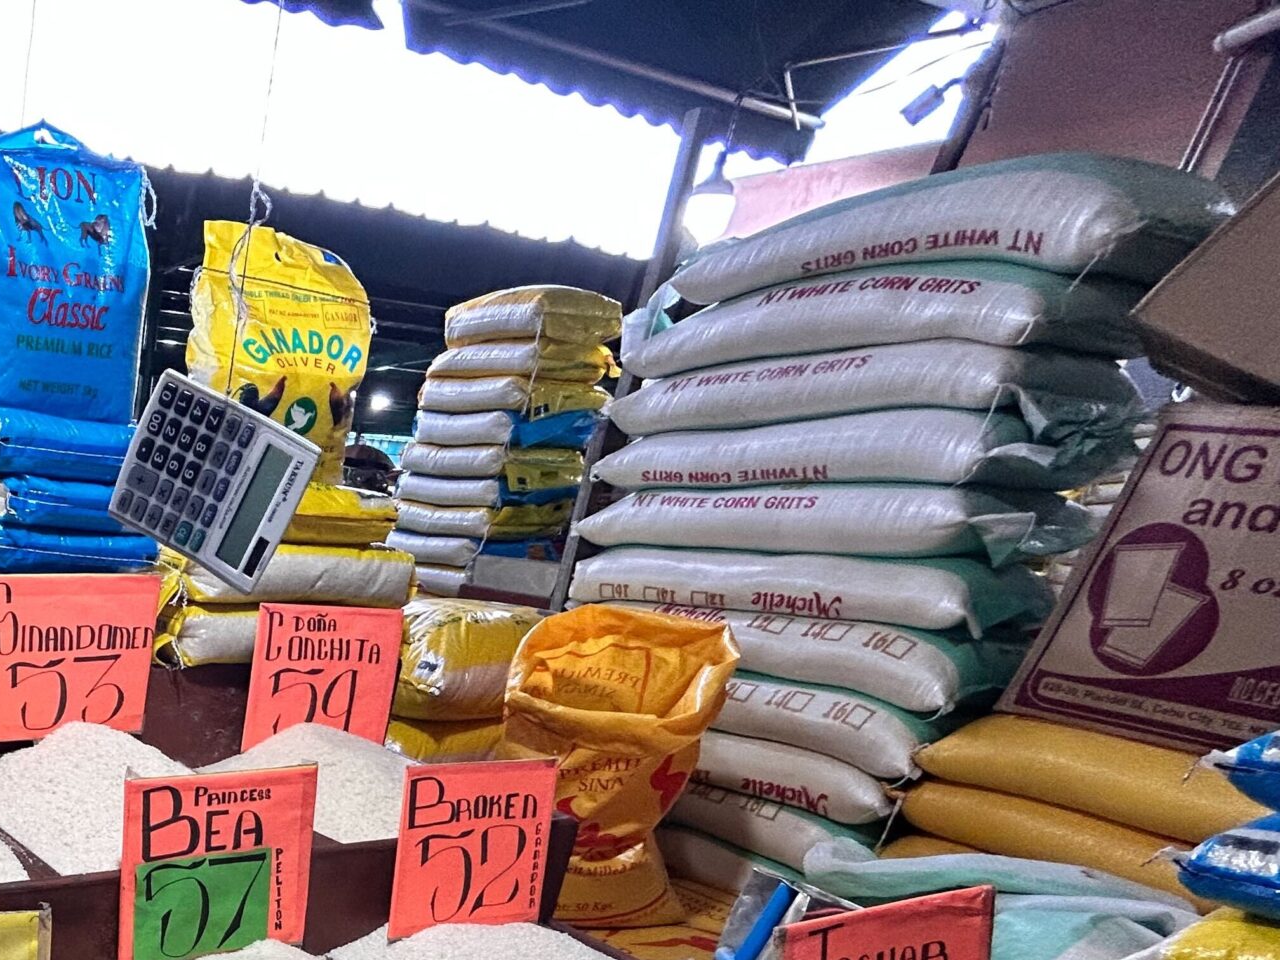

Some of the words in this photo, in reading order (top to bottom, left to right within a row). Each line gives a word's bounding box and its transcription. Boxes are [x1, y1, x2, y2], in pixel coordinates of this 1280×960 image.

[862, 237, 918, 260] CORN
[925, 229, 999, 250] WHITE
[1006, 229, 1045, 255] NT
[6, 244, 59, 283] IVORY
[800, 253, 857, 274] GRITS
[786, 279, 857, 300] WHITE
[858, 275, 919, 292] CORN
[919, 276, 982, 295] GRITS
[27, 287, 110, 331] Classic
[324, 311, 358, 323] GANADOR
[16, 333, 83, 356] PREMIUM
[86, 341, 113, 359] RICE
[242, 327, 363, 374] GANADOR
[276, 356, 337, 375] OLIVER
[663, 375, 697, 395] NT
[696, 370, 756, 387] WHITE
[756, 363, 811, 382] CORN
[812, 354, 873, 375] GRITS
[19, 378, 38, 391] NET
[42, 381, 79, 394] WEIGHT
[161, 391, 172, 401] 0
[148, 414, 162, 431] 00
[193, 406, 202, 417] 4
[167, 427, 176, 436] 2
[181, 433, 191, 444] 5
[154, 453, 164, 463] 3
[196, 442, 206, 452] 8
[169, 460, 179, 471] 6
[1158, 439, 1269, 485] ONG
[184, 468, 194, 480] 9
[641, 469, 684, 483] GRITS
[688, 471, 732, 484] CORN
[738, 466, 802, 482] WHITE
[631, 493, 661, 508] NT
[660, 495, 707, 508] WHITE
[712, 496, 758, 509] CORN
[764, 495, 819, 509] GRITS
[1219, 568, 1246, 591] 8
[750, 591, 843, 620] Michelle
[292, 612, 338, 633] DOÑA
[265, 611, 382, 665] CONCHITA
[861, 631, 887, 650] 16
[5, 654, 125, 731] 53
[268, 667, 359, 736] 59
[765, 689, 786, 709] 14
[821, 699, 845, 722] 16
[193, 786, 272, 807] PRINCESS
[407, 776, 538, 831] BROKEN
[741, 777, 830, 816] Michelle
[141, 785, 264, 863] BEA
[414, 824, 527, 923] 52
[528, 821, 543, 910] GANADOR
[274, 847, 284, 931] PELITON
[142, 852, 268, 958] 57
